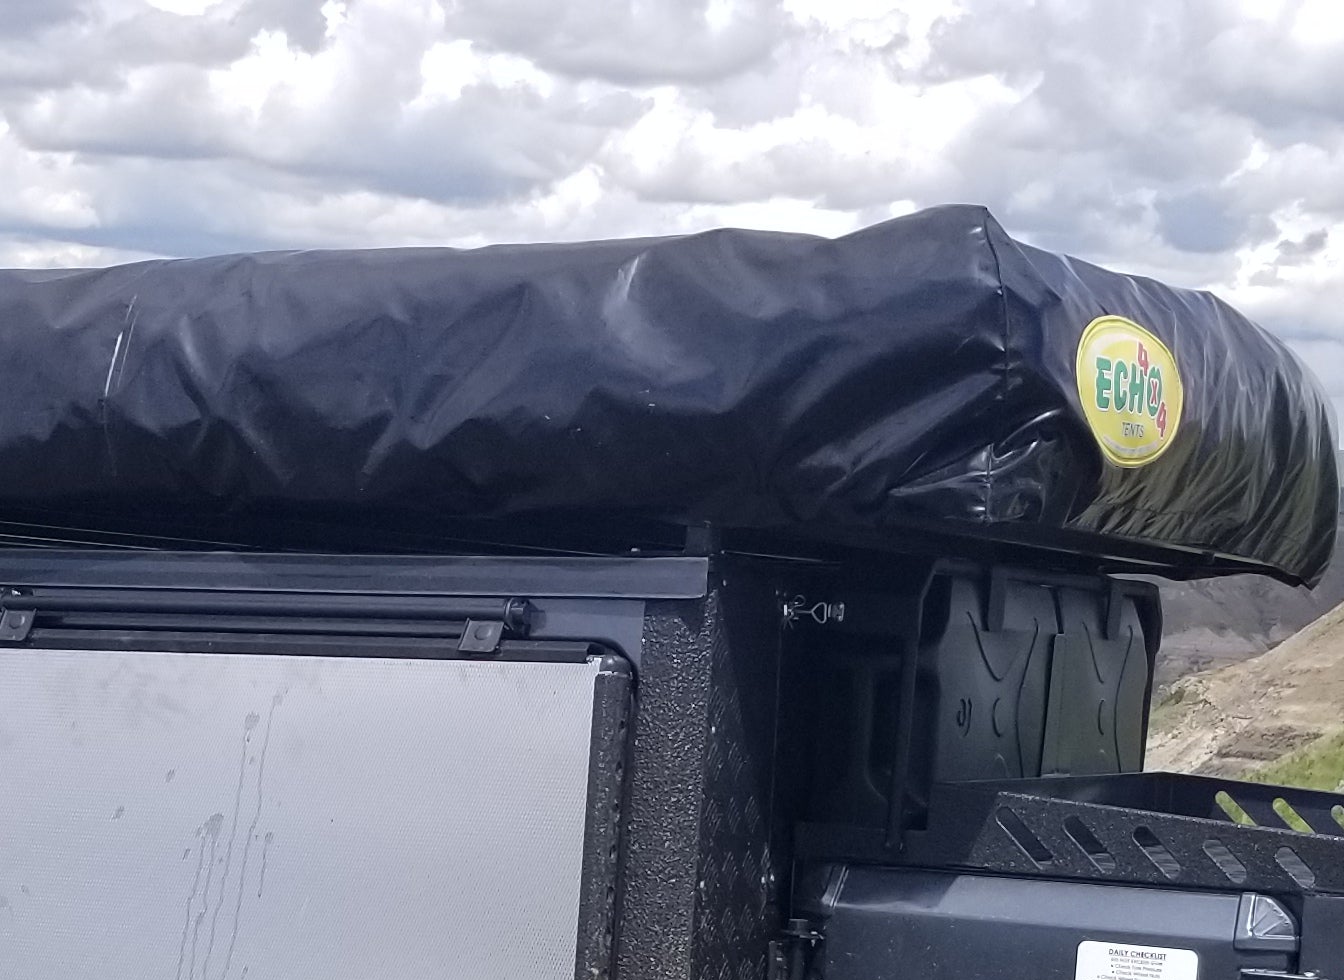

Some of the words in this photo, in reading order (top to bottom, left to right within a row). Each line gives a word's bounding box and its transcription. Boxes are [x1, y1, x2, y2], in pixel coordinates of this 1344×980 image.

[1096, 356, 1163, 417] ECHO
[1122, 421, 1145, 438] TENTS
[1109, 949, 1128, 957] DAILY
[1130, 951, 1166, 960] CHECKLIST
